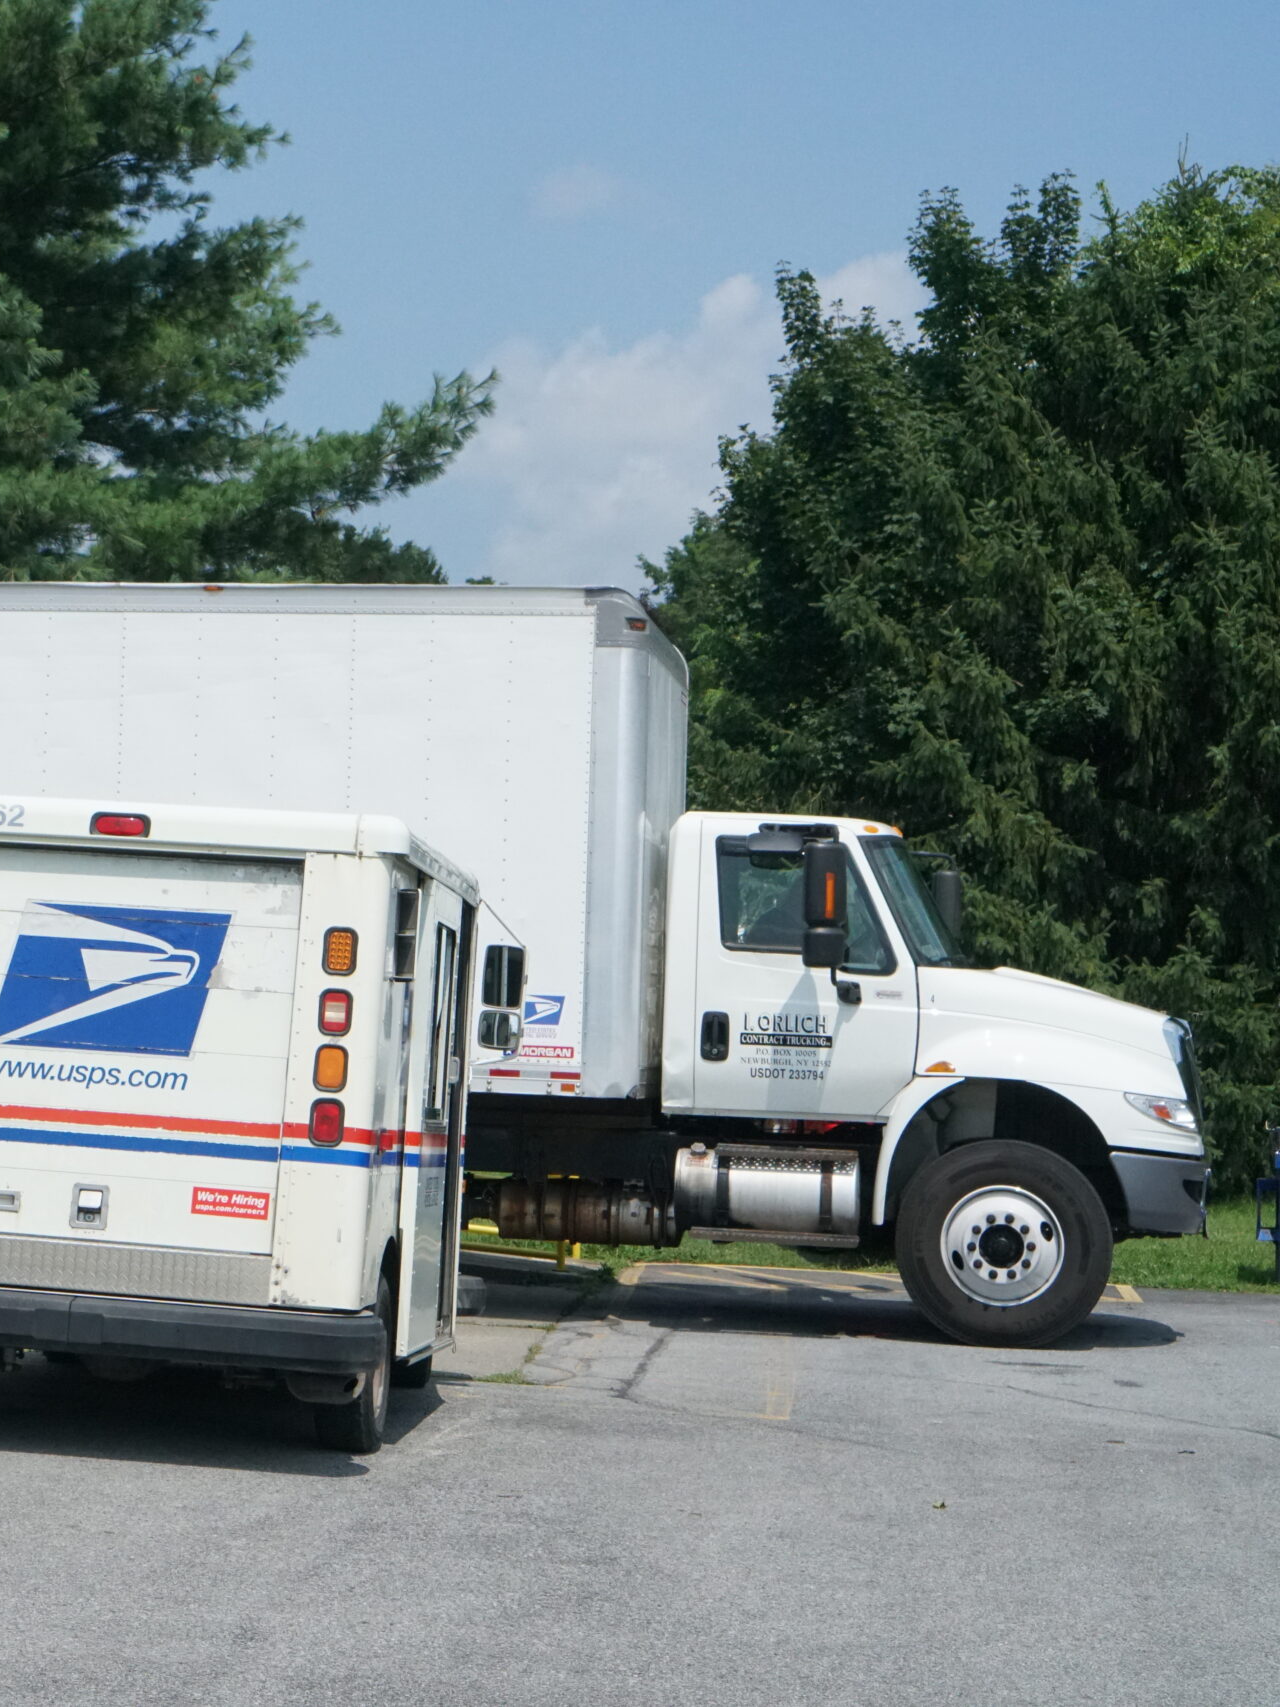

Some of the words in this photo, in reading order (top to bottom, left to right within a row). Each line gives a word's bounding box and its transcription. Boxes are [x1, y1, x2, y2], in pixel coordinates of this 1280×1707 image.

[757, 1012, 827, 1034] ORLICH
[741, 1034, 784, 1045] CONTRACT
[786, 1036, 826, 1047] TRUCKING
[773, 1048, 792, 1056] BOX
[796, 1059, 808, 1067] NY
[750, 1067, 786, 1078] USDOT
[788, 1069, 824, 1080] 233794
[197, 1191, 228, 1203] We're
[230, 1194, 266, 1208] Hiring
[195, 1204, 265, 1215] usps.com/careers
